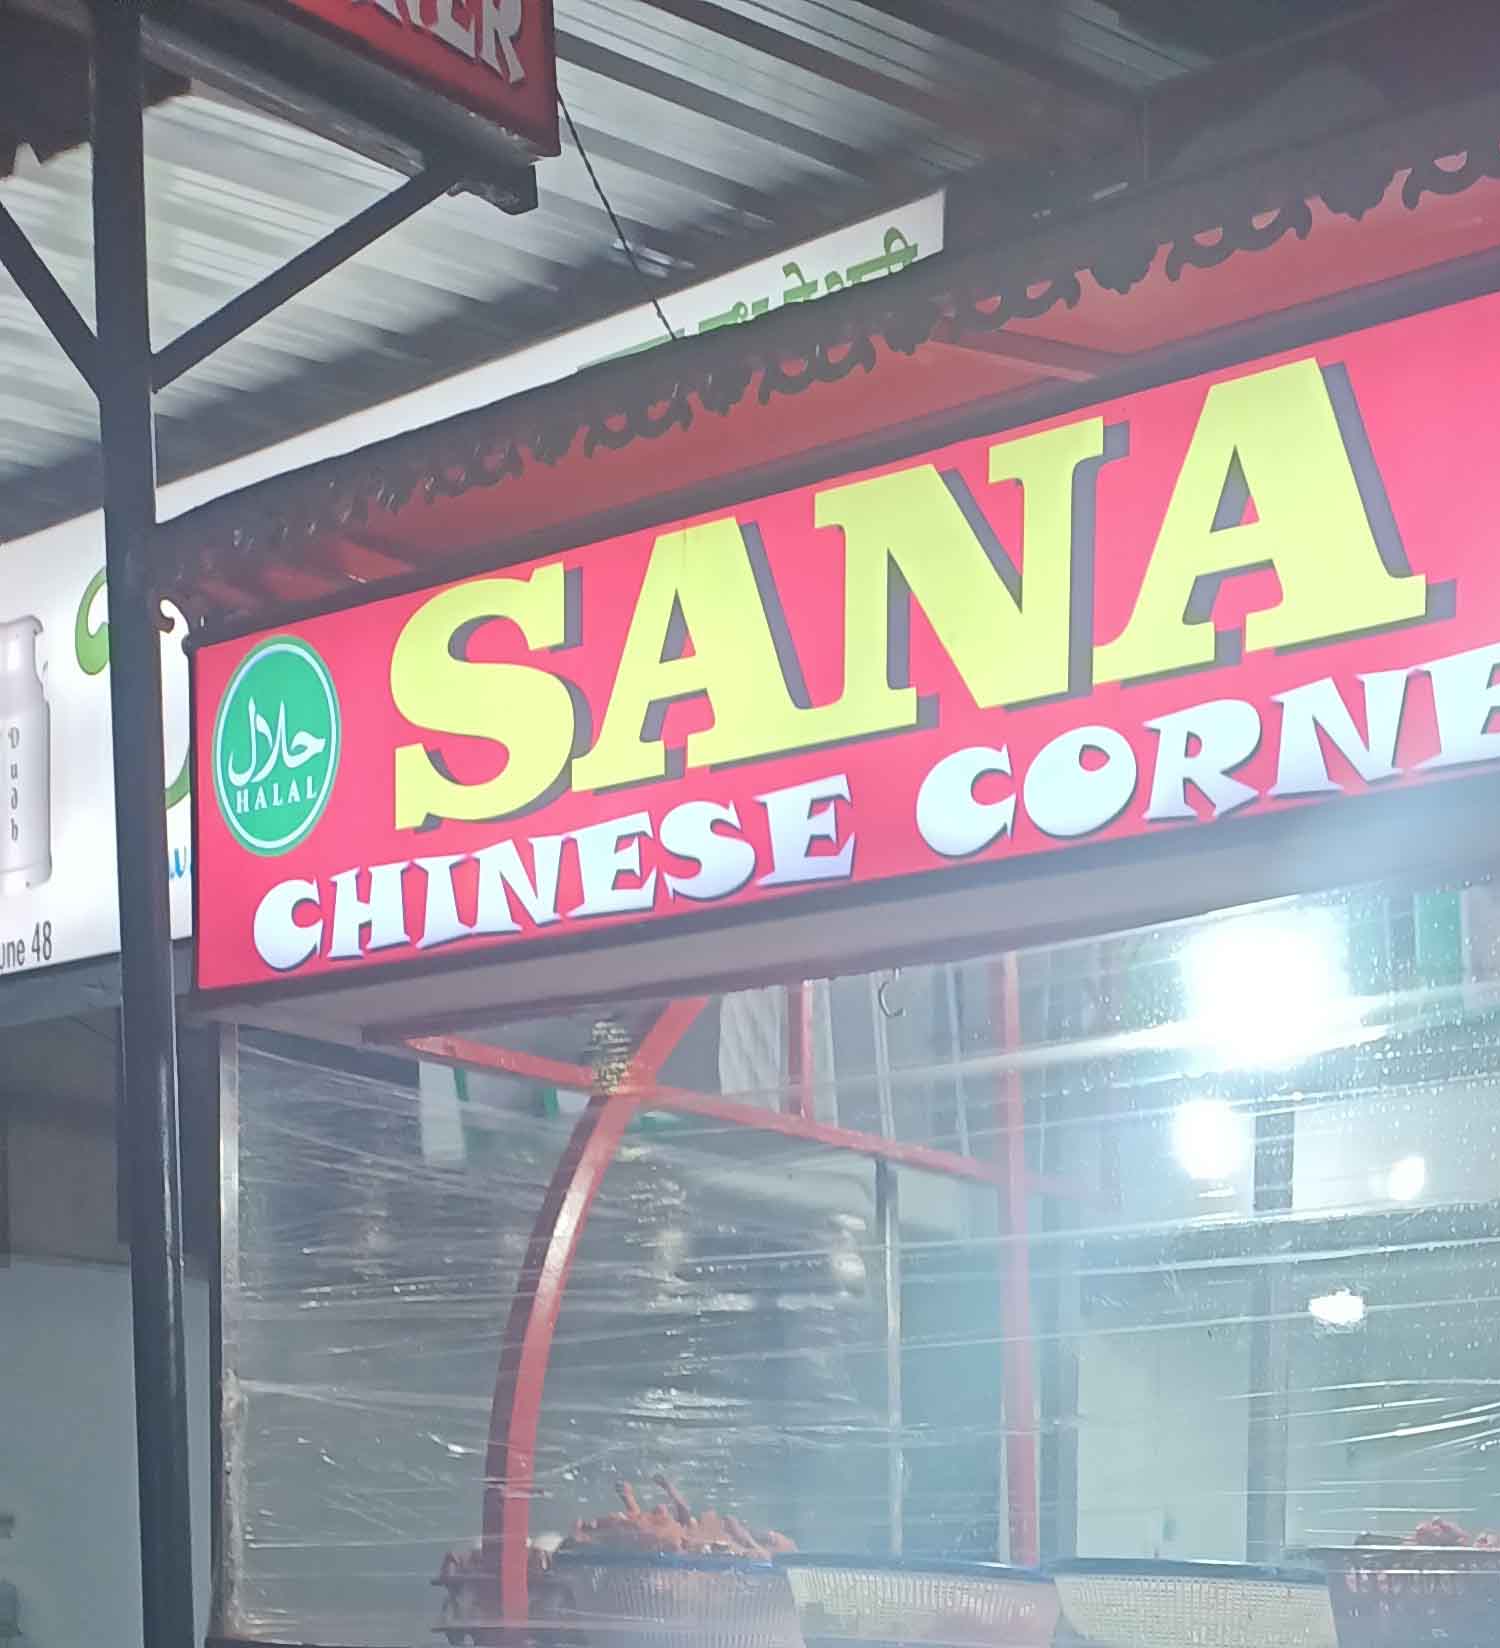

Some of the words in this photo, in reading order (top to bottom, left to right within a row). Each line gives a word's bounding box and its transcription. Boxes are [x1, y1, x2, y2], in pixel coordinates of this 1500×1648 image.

[390, 357, 1427, 828] SANA
[227, 696, 326, 786] حلال
[236, 775, 317, 815] HALAL
[252, 773, 857, 972] CHINESE
[31, 920, 52, 962] 48
